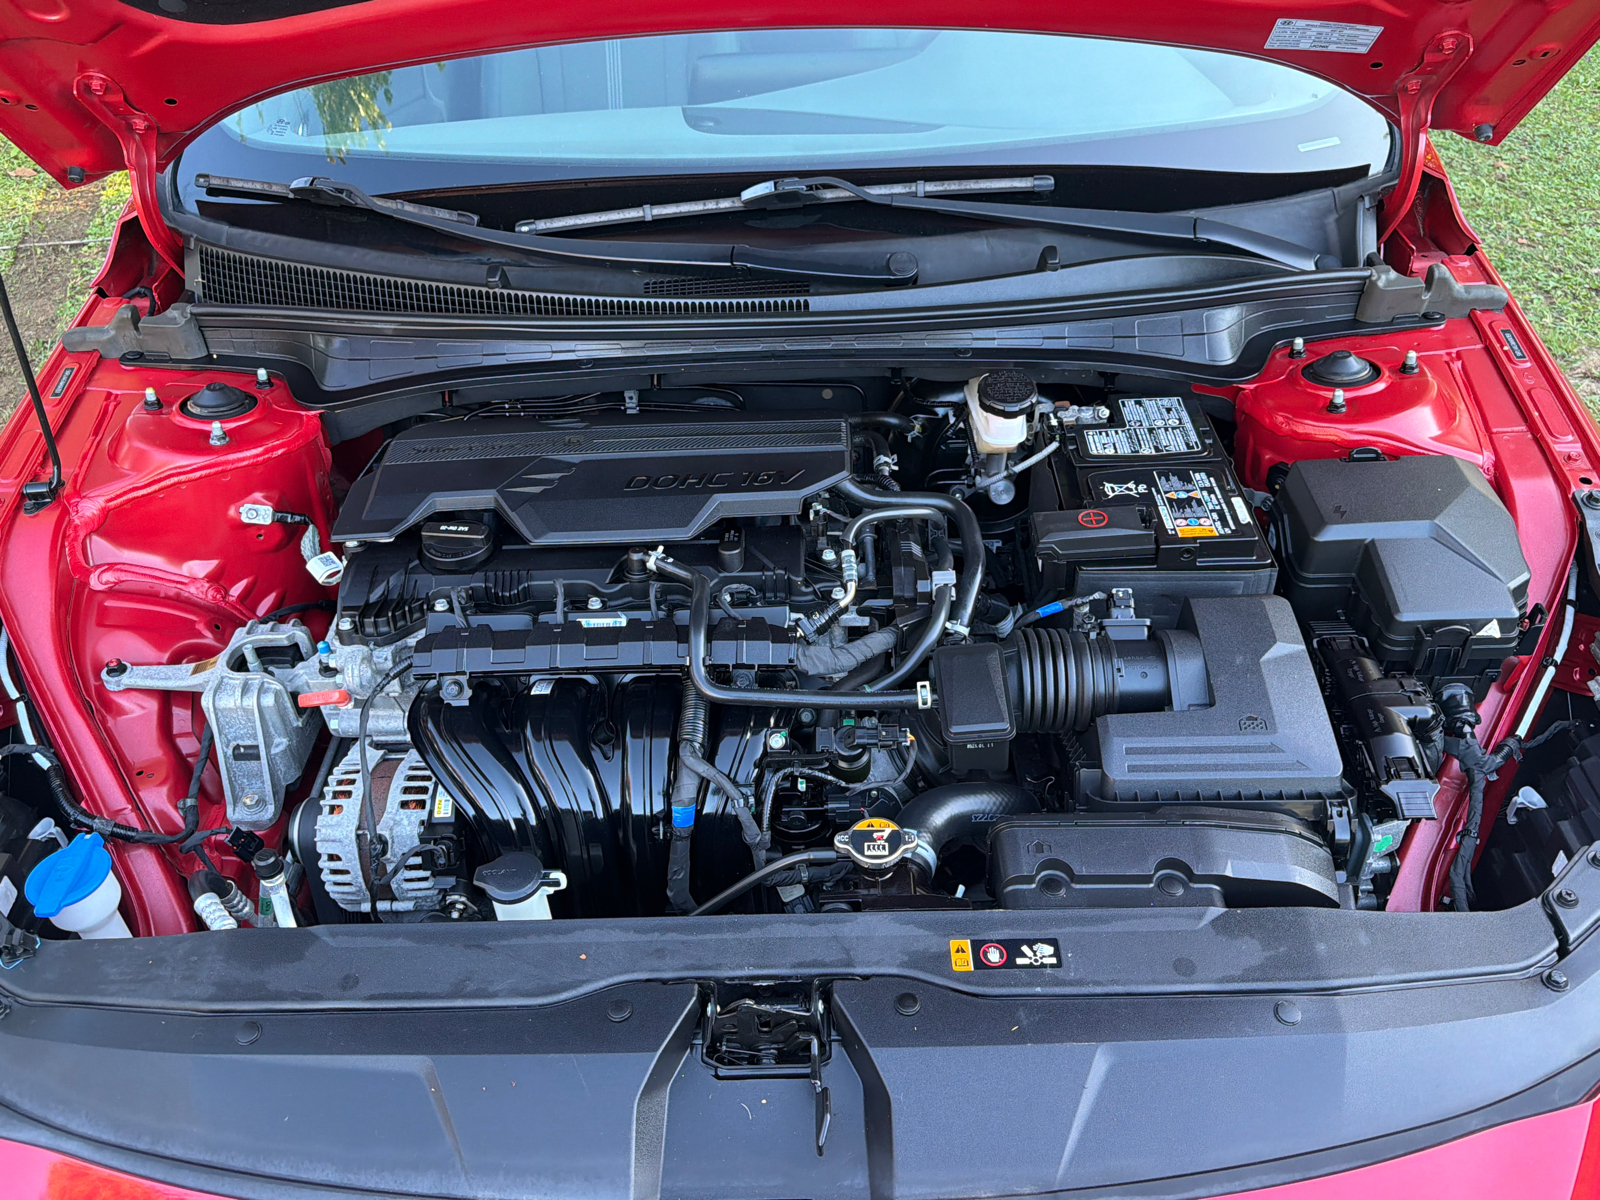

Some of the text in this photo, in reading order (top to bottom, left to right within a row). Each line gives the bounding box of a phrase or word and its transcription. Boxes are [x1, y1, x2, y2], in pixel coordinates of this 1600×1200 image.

[623, 469, 806, 491] DOHC 16V
[836, 834, 849, 842] HCC
[904, 834, 915, 842] 1.1
[482, 868, 519, 877] COOLANT
